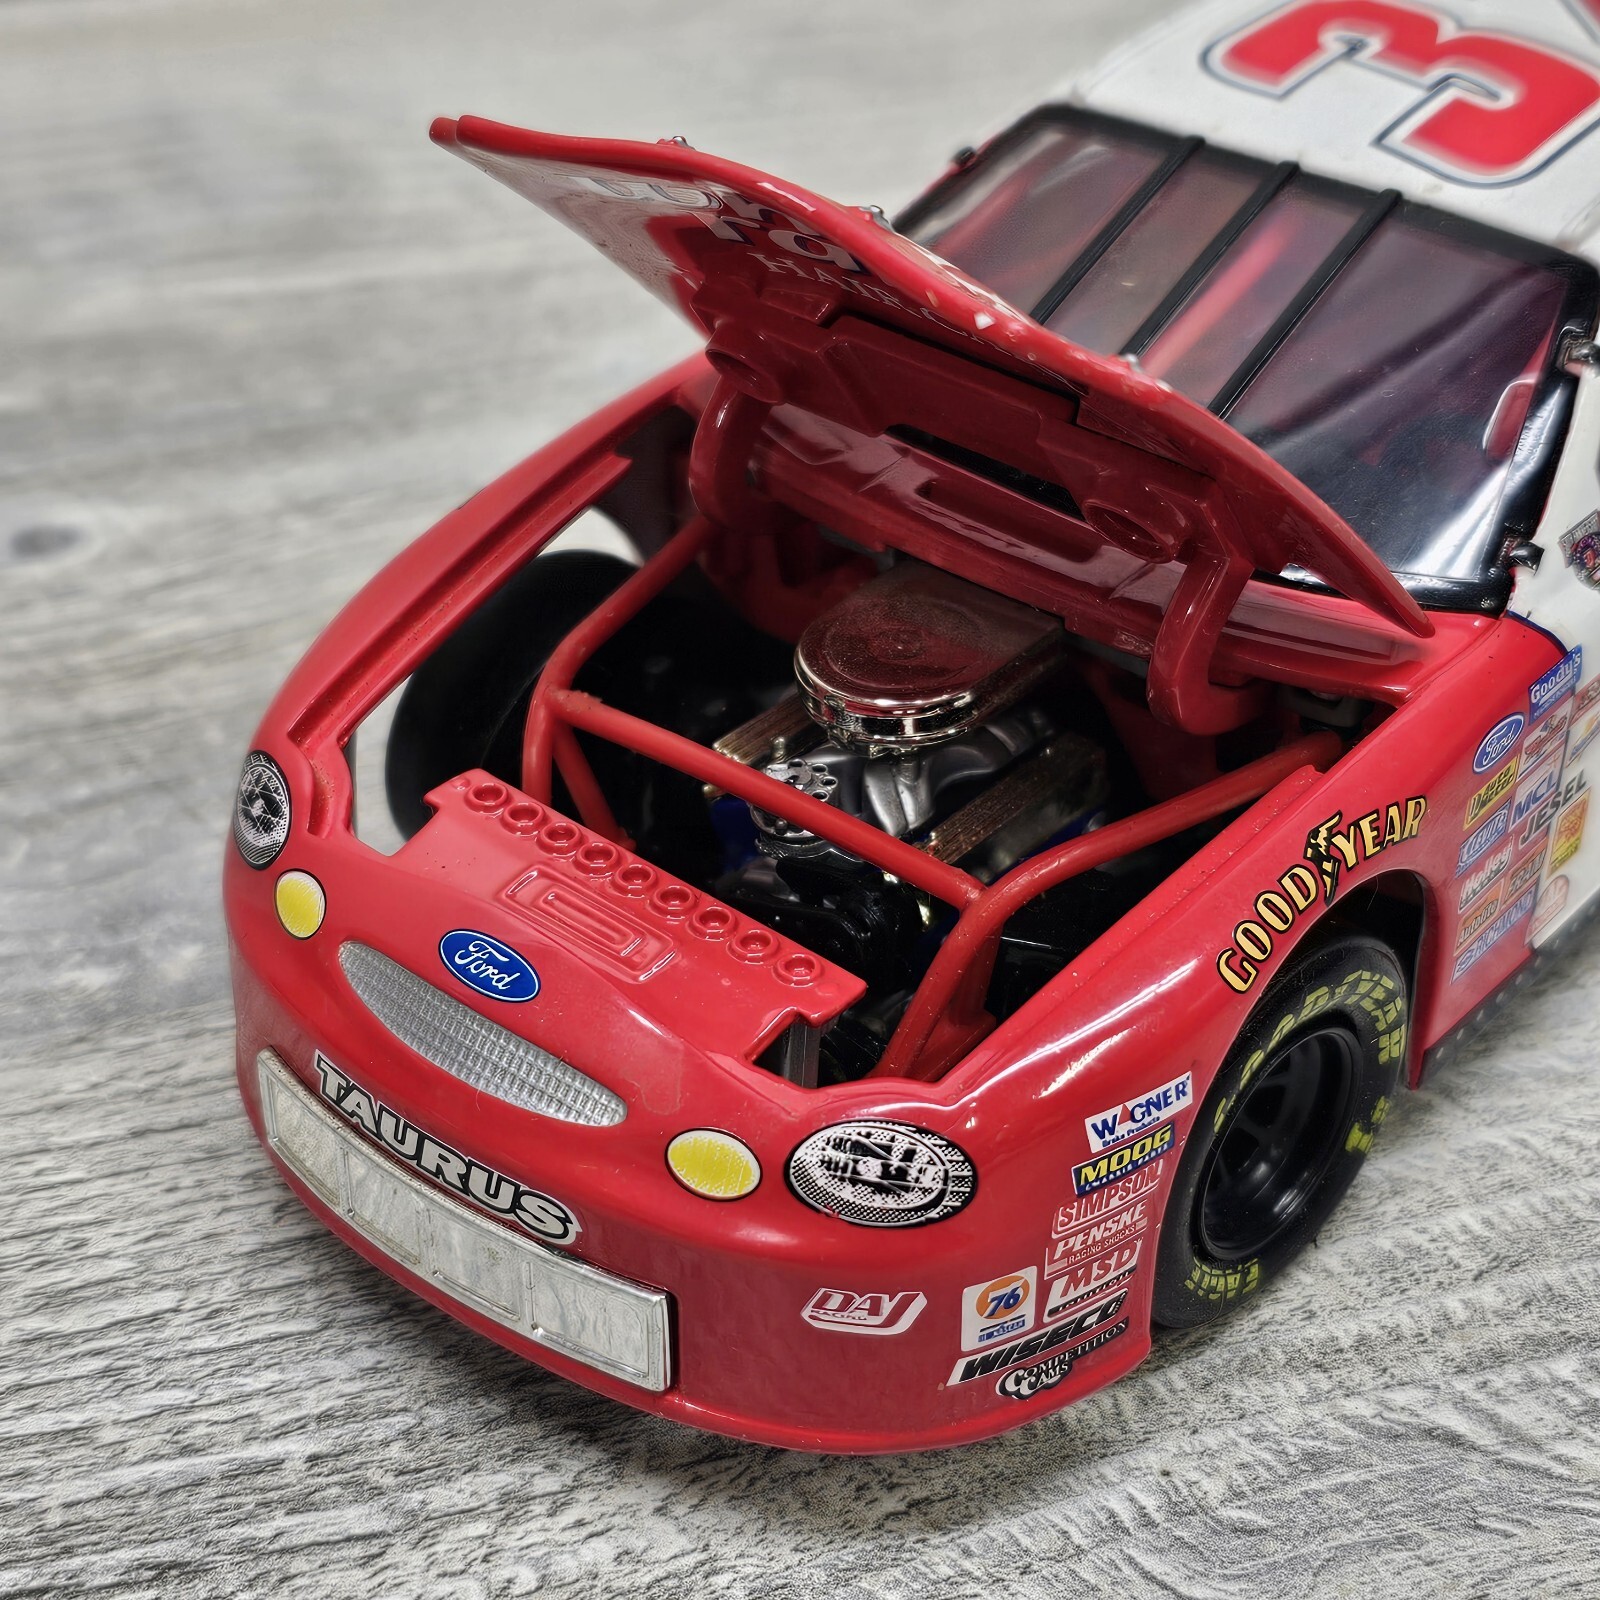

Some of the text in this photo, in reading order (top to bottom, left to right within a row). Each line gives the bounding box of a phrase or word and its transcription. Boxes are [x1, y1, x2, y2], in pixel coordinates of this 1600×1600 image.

[1199, 0, 1600, 190] 3
[1530, 652, 1581, 704] Goody's
[1483, 723, 1515, 766] Ford
[1519, 768, 1587, 846] JESEL
[453, 939, 524, 991] Ford
[314, 1053, 579, 1245] TAURUS
[1080, 1123, 1172, 1187] MOOG
[1057, 1159, 1163, 1230] SIMPSON
[1053, 1198, 1148, 1260] PENSKE
[1068, 1243, 1102, 1265] RACING
[1060, 1239, 1140, 1299] MSD
[984, 1284, 1022, 1318] 76
[959, 1289, 1127, 1383] WISECO
[1020, 1360, 1069, 1396] CAMS
